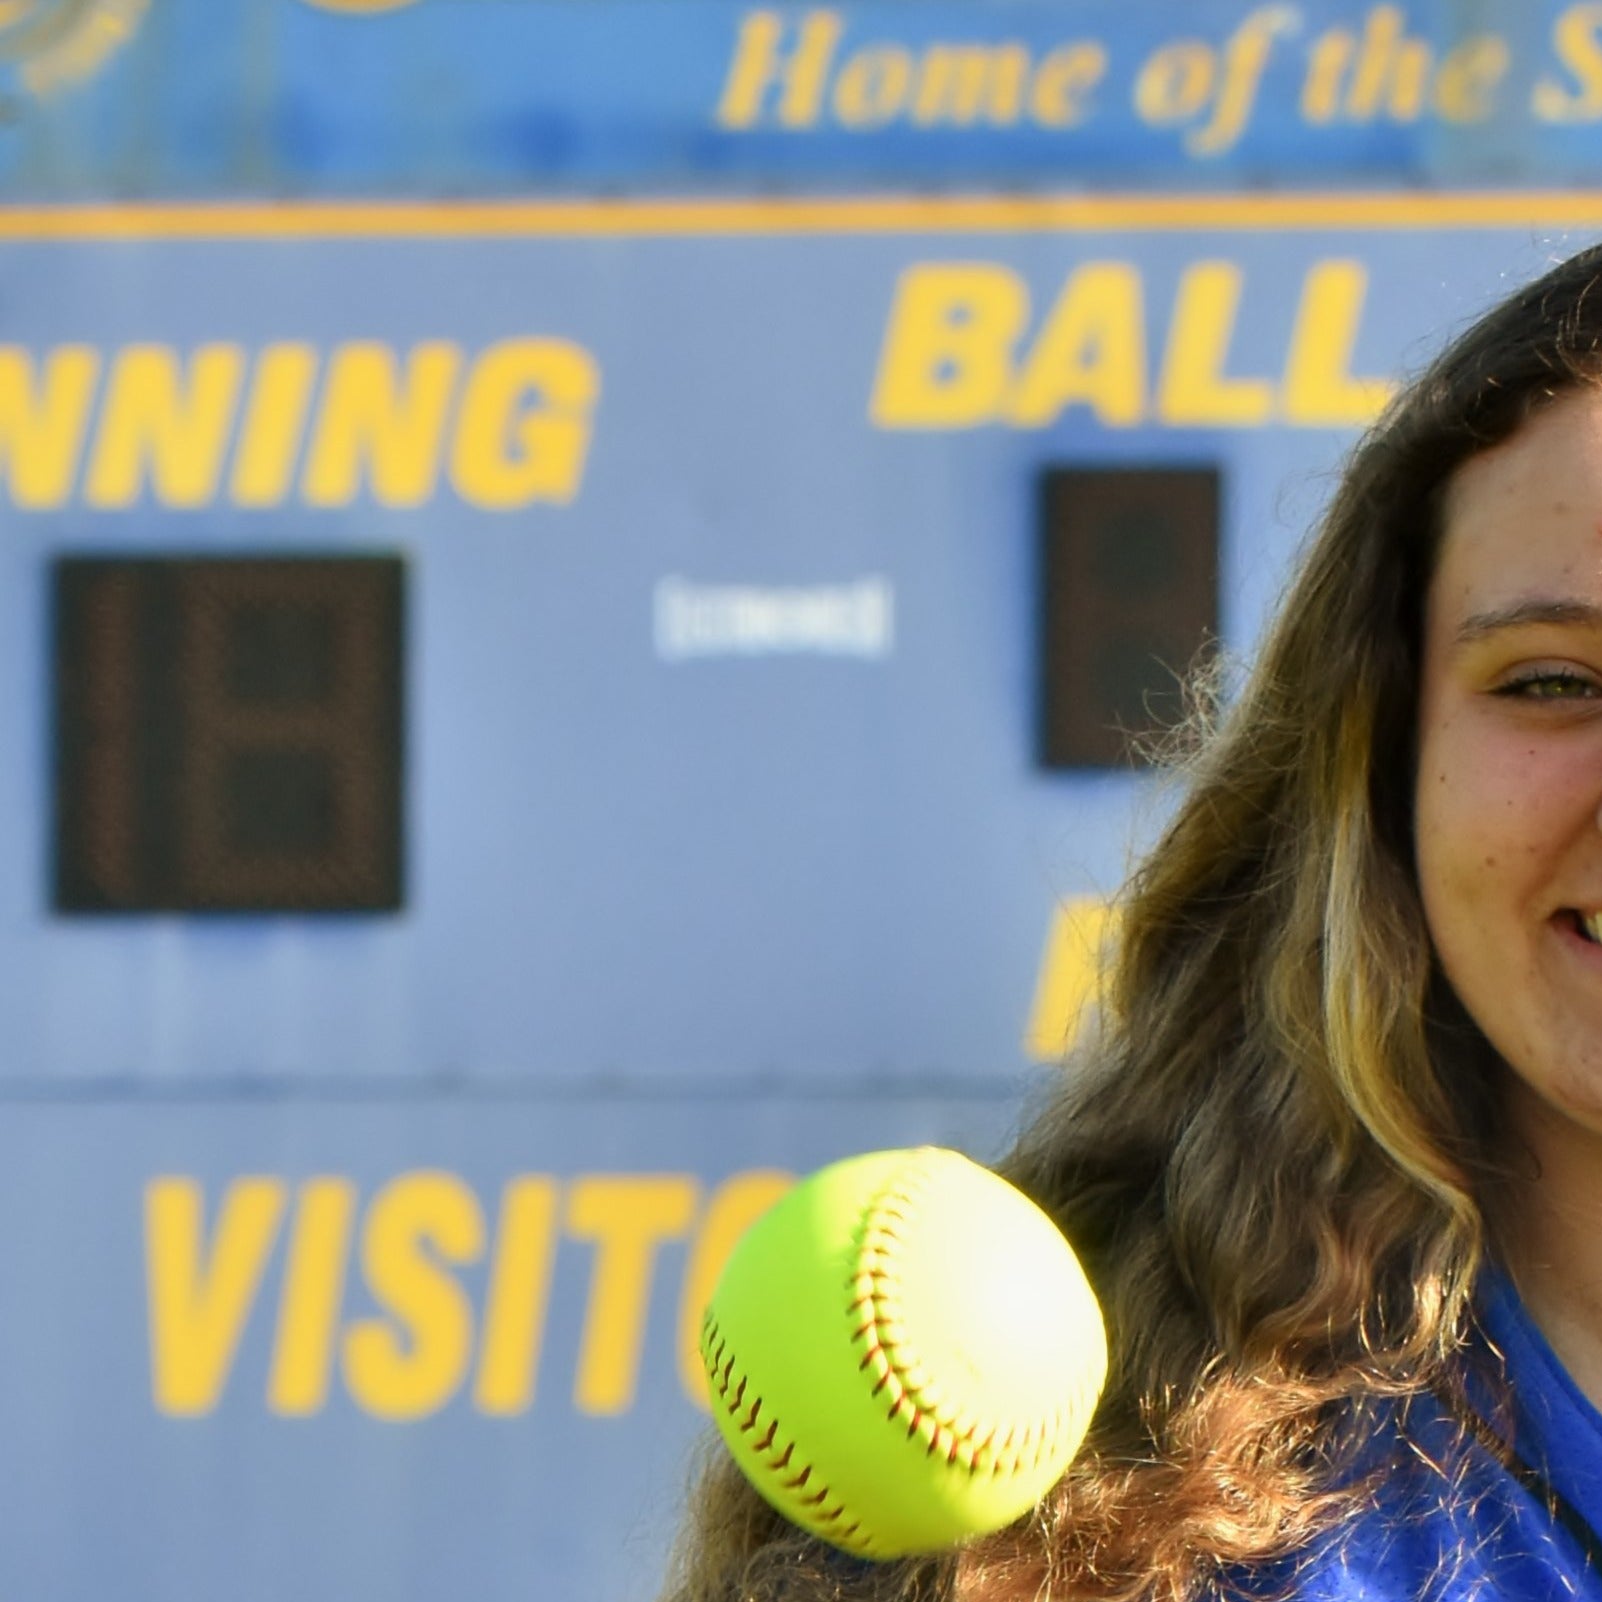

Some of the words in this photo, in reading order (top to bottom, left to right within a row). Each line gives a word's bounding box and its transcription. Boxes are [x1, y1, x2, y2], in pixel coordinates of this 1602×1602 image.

[716, 8, 1109, 130] Home
[1130, 4, 1304, 158] of
[1300, 3, 1510, 126] the
[0, 335, 602, 512] NNING
[870, 259, 1400, 430] BALL
